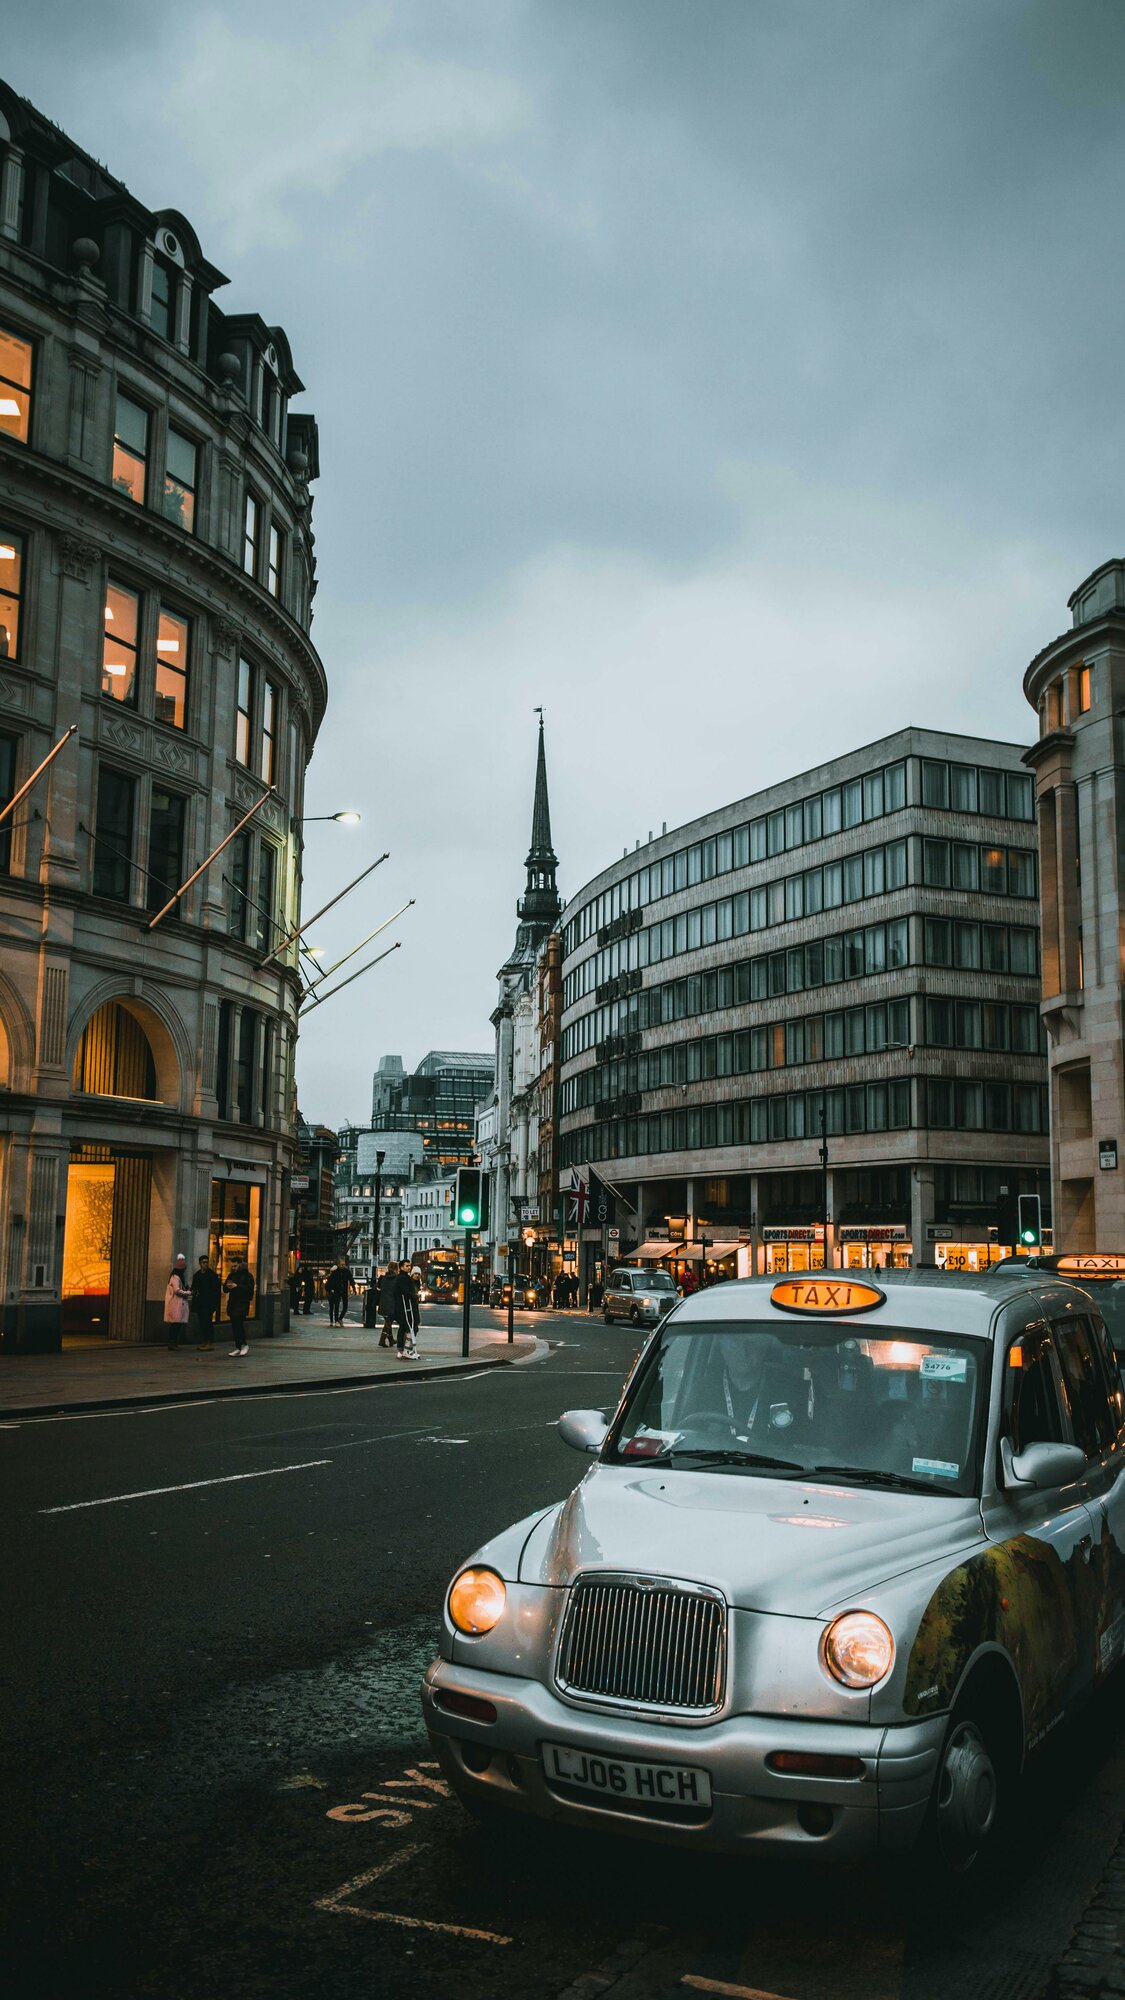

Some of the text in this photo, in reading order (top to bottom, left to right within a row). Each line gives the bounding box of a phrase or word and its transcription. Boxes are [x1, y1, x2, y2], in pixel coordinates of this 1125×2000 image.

[948, 1255, 966, 1266] £10
[1073, 1259, 1119, 1268] TAXI
[791, 1286, 852, 1306] TAXI
[553, 1749, 698, 1801] LJ06 HCH
